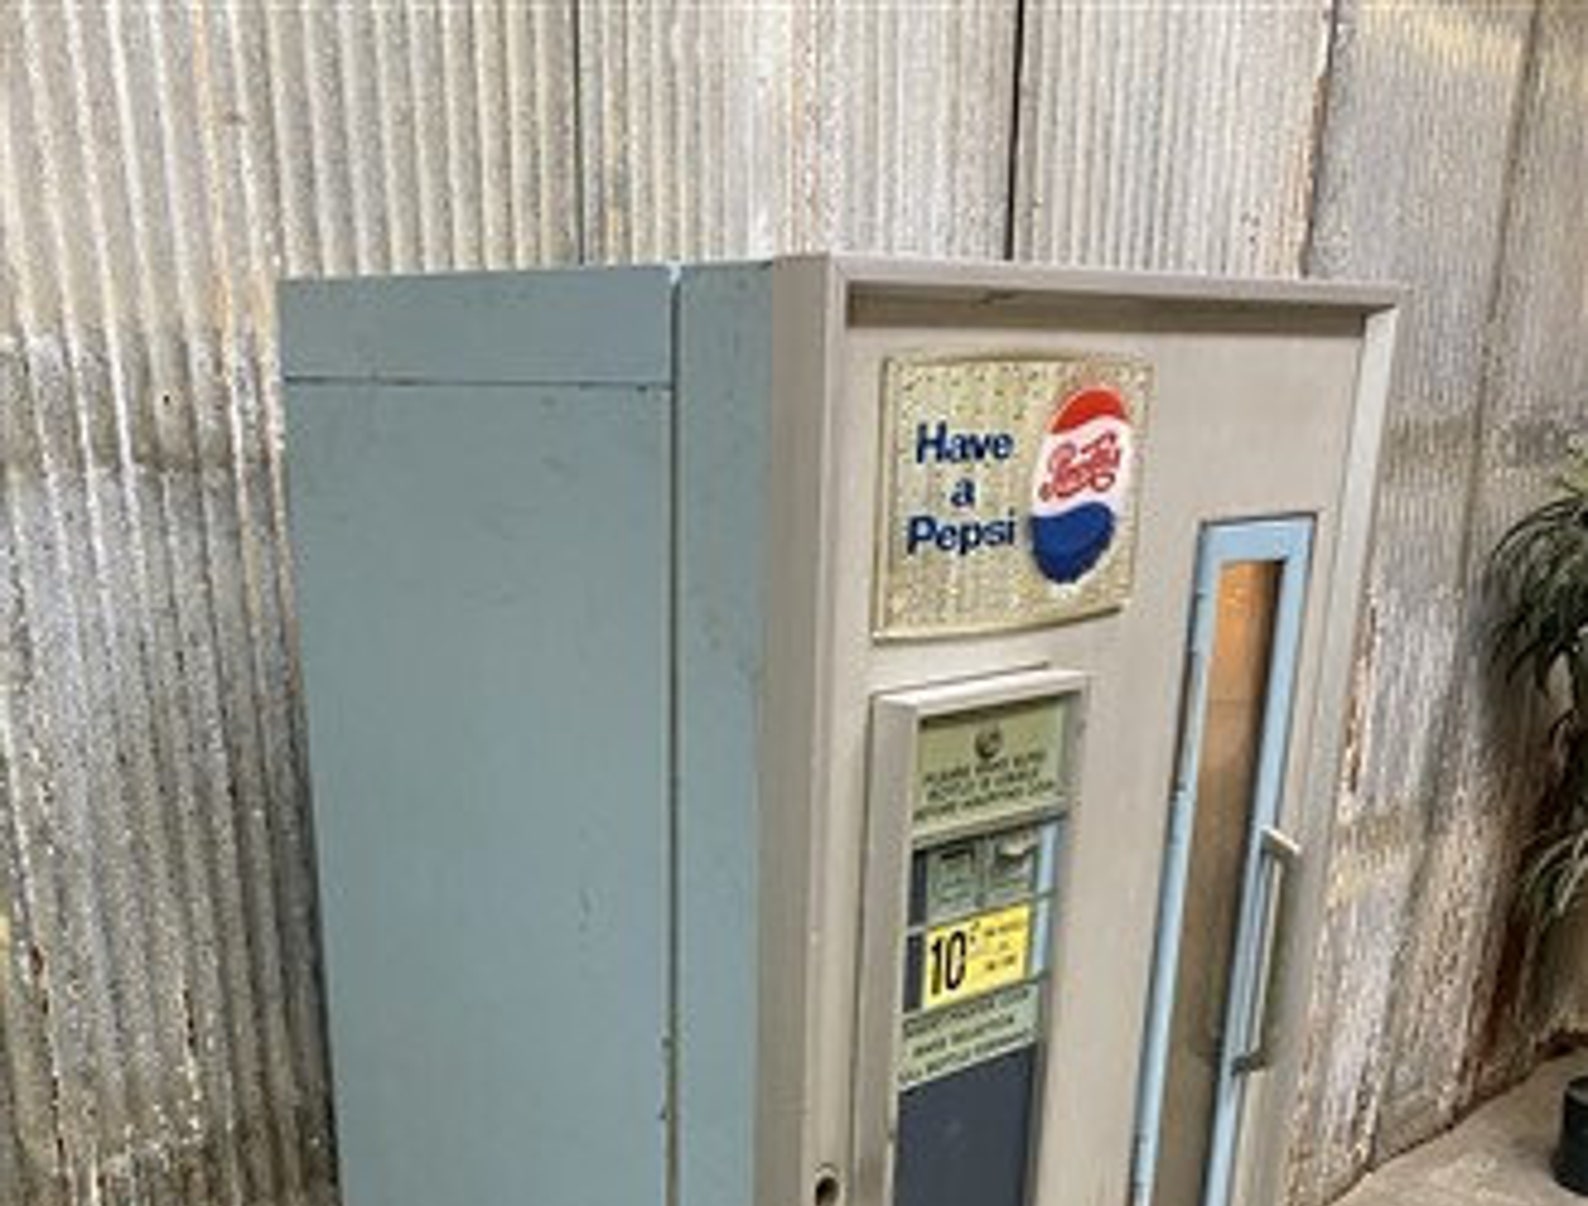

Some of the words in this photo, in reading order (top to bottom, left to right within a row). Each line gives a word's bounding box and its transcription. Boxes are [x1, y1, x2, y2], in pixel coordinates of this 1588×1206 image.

[915, 420, 1014, 464] Have
[950, 477, 977, 508] a
[906, 506, 1016, 556] Pepsi
